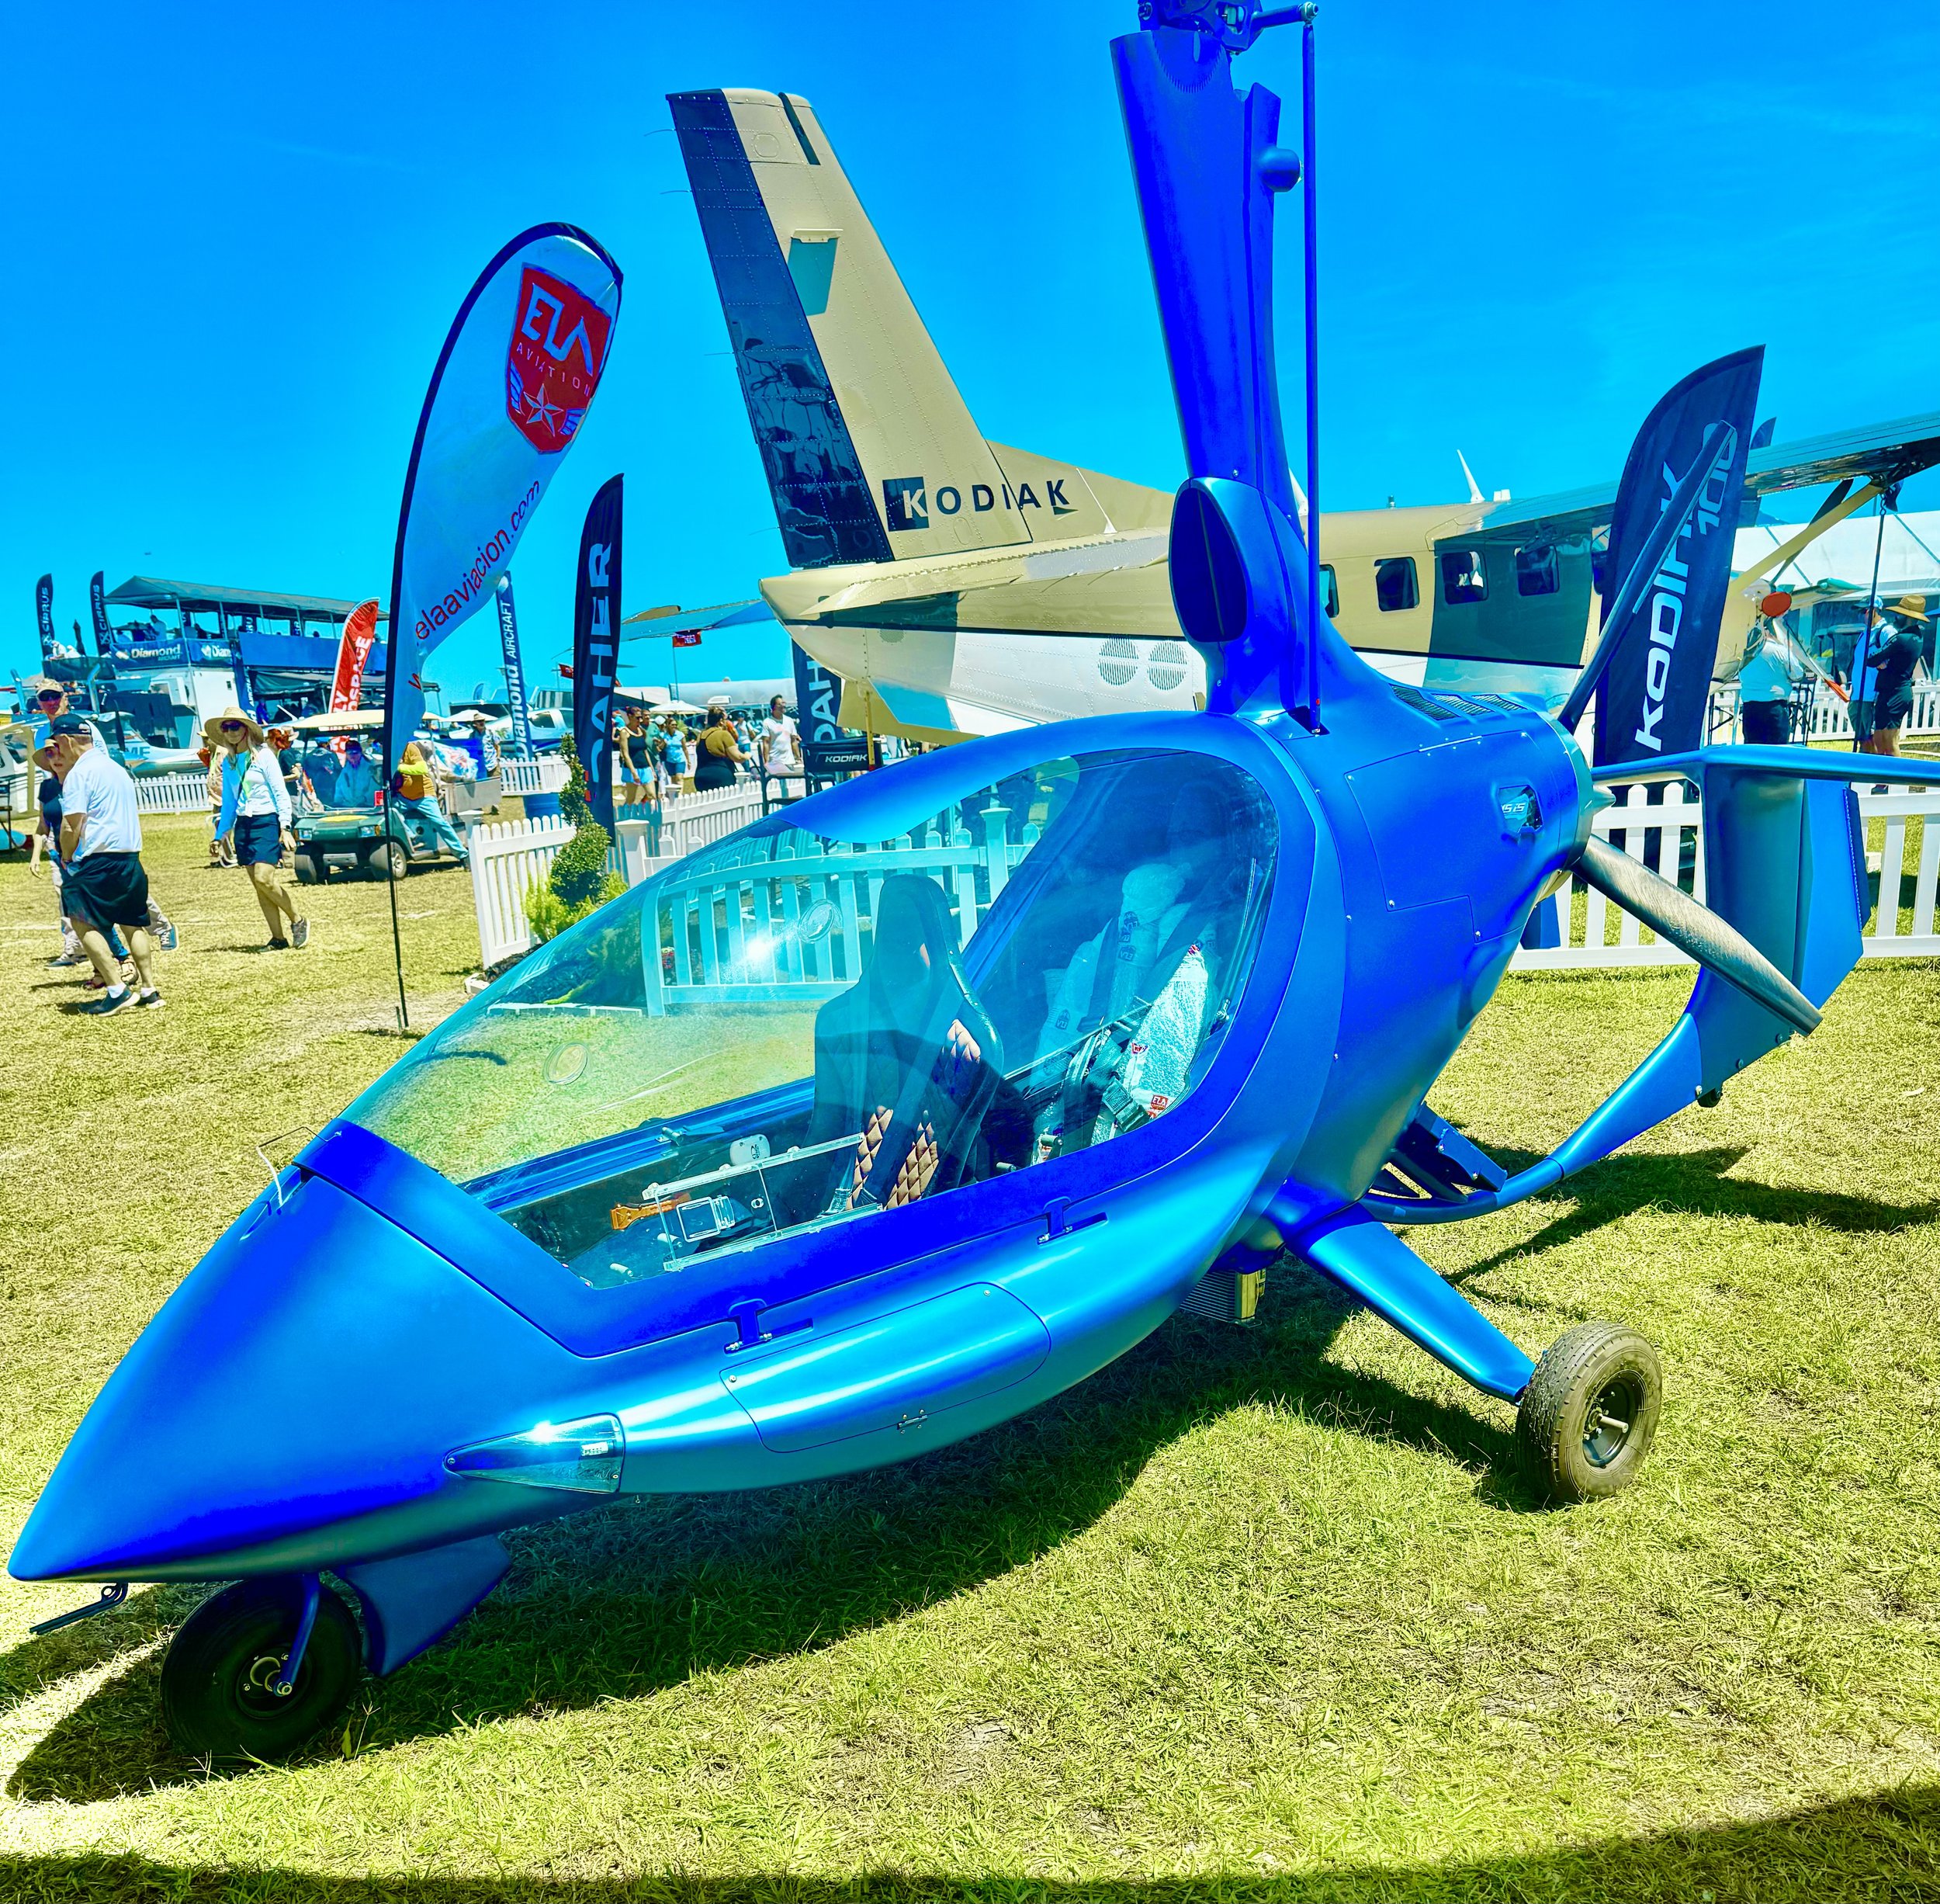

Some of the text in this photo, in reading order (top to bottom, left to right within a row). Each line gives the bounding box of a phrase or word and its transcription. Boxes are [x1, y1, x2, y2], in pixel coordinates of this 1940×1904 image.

[521, 282, 594, 378] ELA
[516, 342, 591, 398] AVIATION
[902, 479, 1070, 518] KODIAK
[41, 587, 50, 633] CIRRUS
[501, 600, 518, 659] AIRCRAFT
[130, 643, 181, 659] Diamond
[212, 645, 232, 657] Diam
[805, 650, 836, 742] DAH
[825, 754, 868, 763] KODIAK
